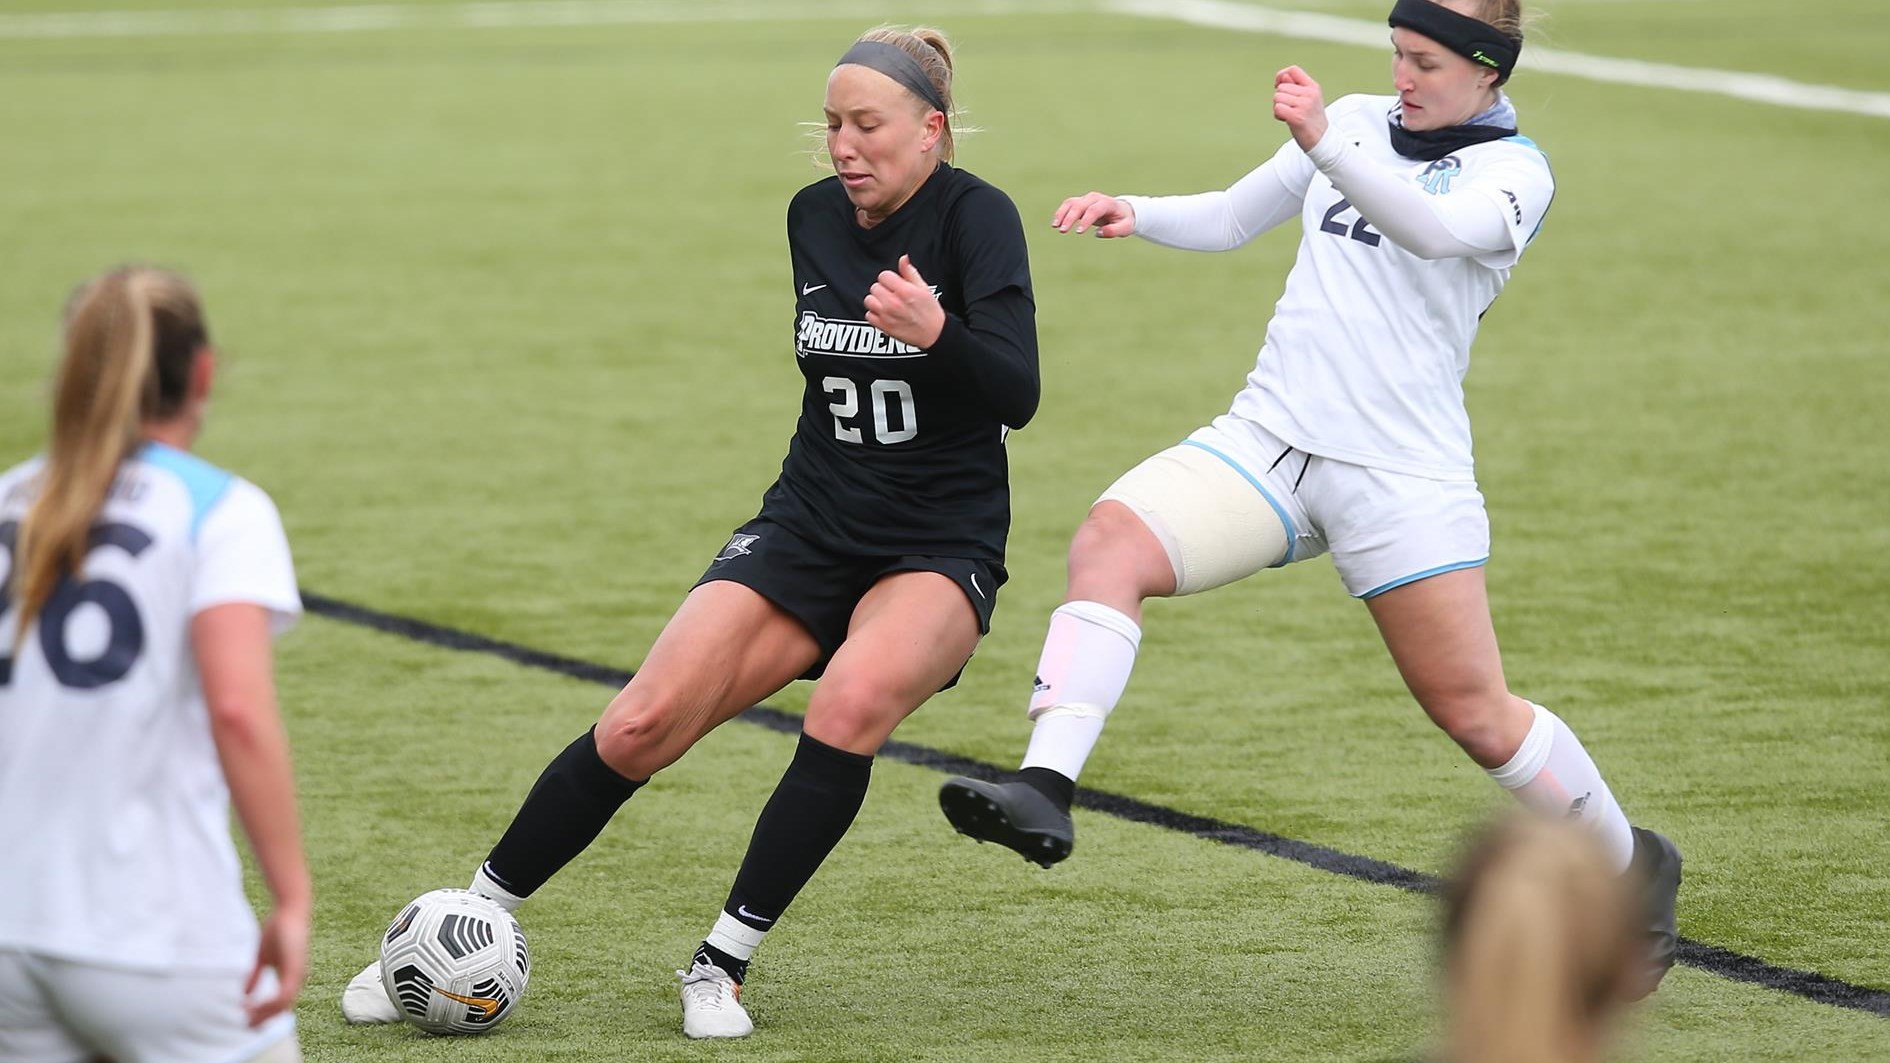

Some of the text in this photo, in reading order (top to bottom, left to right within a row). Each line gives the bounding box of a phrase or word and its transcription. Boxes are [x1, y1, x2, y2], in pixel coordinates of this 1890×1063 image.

[798, 314, 922, 355] PROVIDEN
[822, 376, 918, 444] 20
[0, 520, 153, 689] 6
